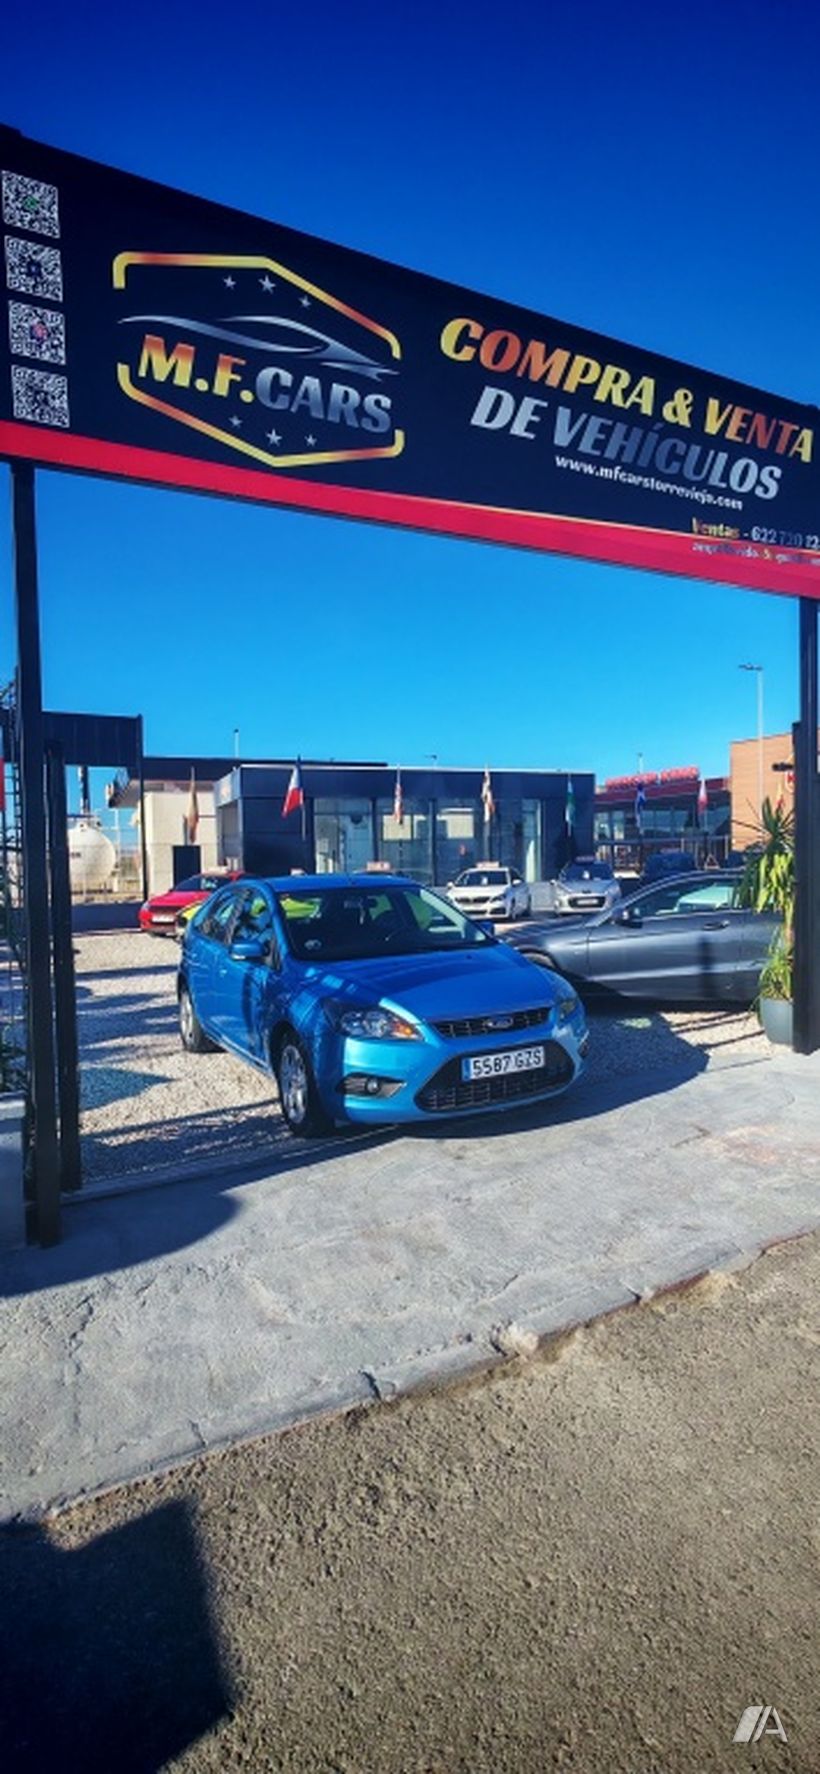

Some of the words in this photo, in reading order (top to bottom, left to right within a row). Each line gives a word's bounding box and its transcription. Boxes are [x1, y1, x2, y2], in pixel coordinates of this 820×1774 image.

[440, 317, 655, 416] COMPRA
[662, 387, 694, 428] &
[704, 397, 813, 463] VENTA
[470, 386, 548, 440] DE
[552, 406, 782, 500] VEHÍCULOS
